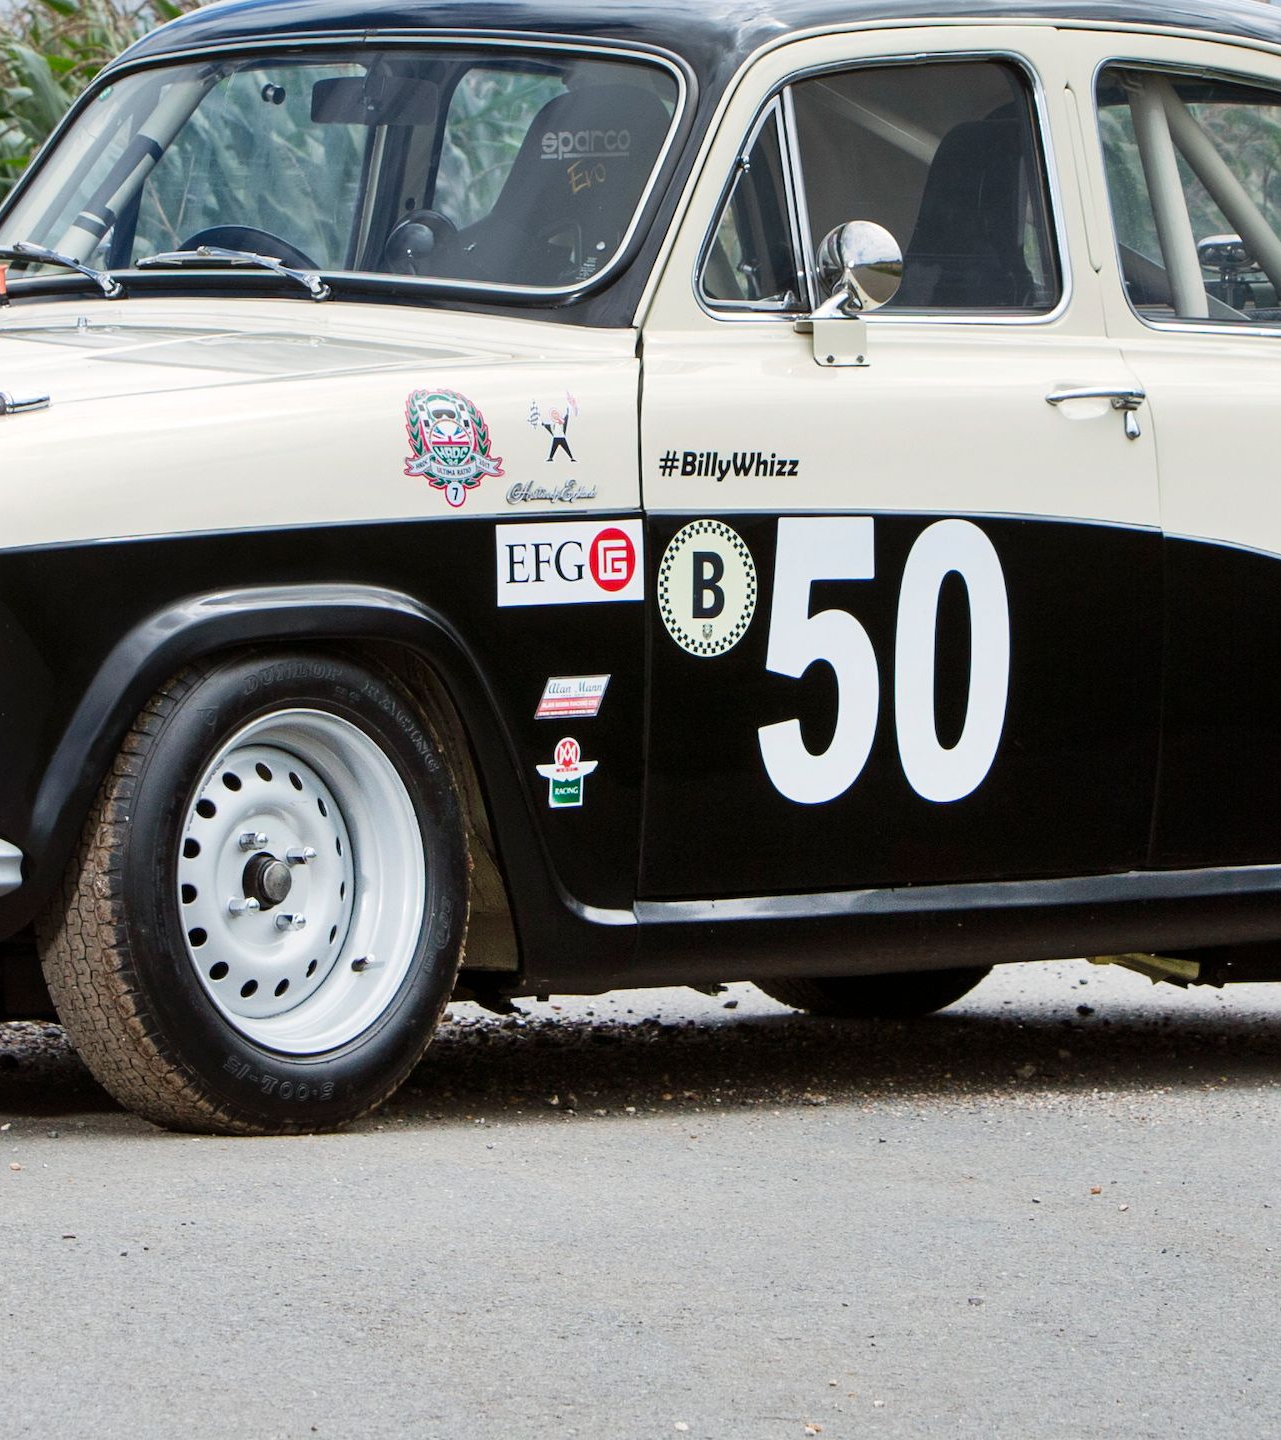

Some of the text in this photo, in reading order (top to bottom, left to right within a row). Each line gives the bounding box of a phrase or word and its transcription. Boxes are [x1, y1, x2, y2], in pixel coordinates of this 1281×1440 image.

[541, 129, 631, 160] sparco
[567, 160, 606, 193] Evo
[659, 449, 800, 482] #BillyWhizz
[452, 487, 459, 501] 7
[505, 540, 585, 584] EFG
[692, 551, 725, 619] B
[758, 516, 1010, 804] 50
[554, 786, 579, 796] RACING
